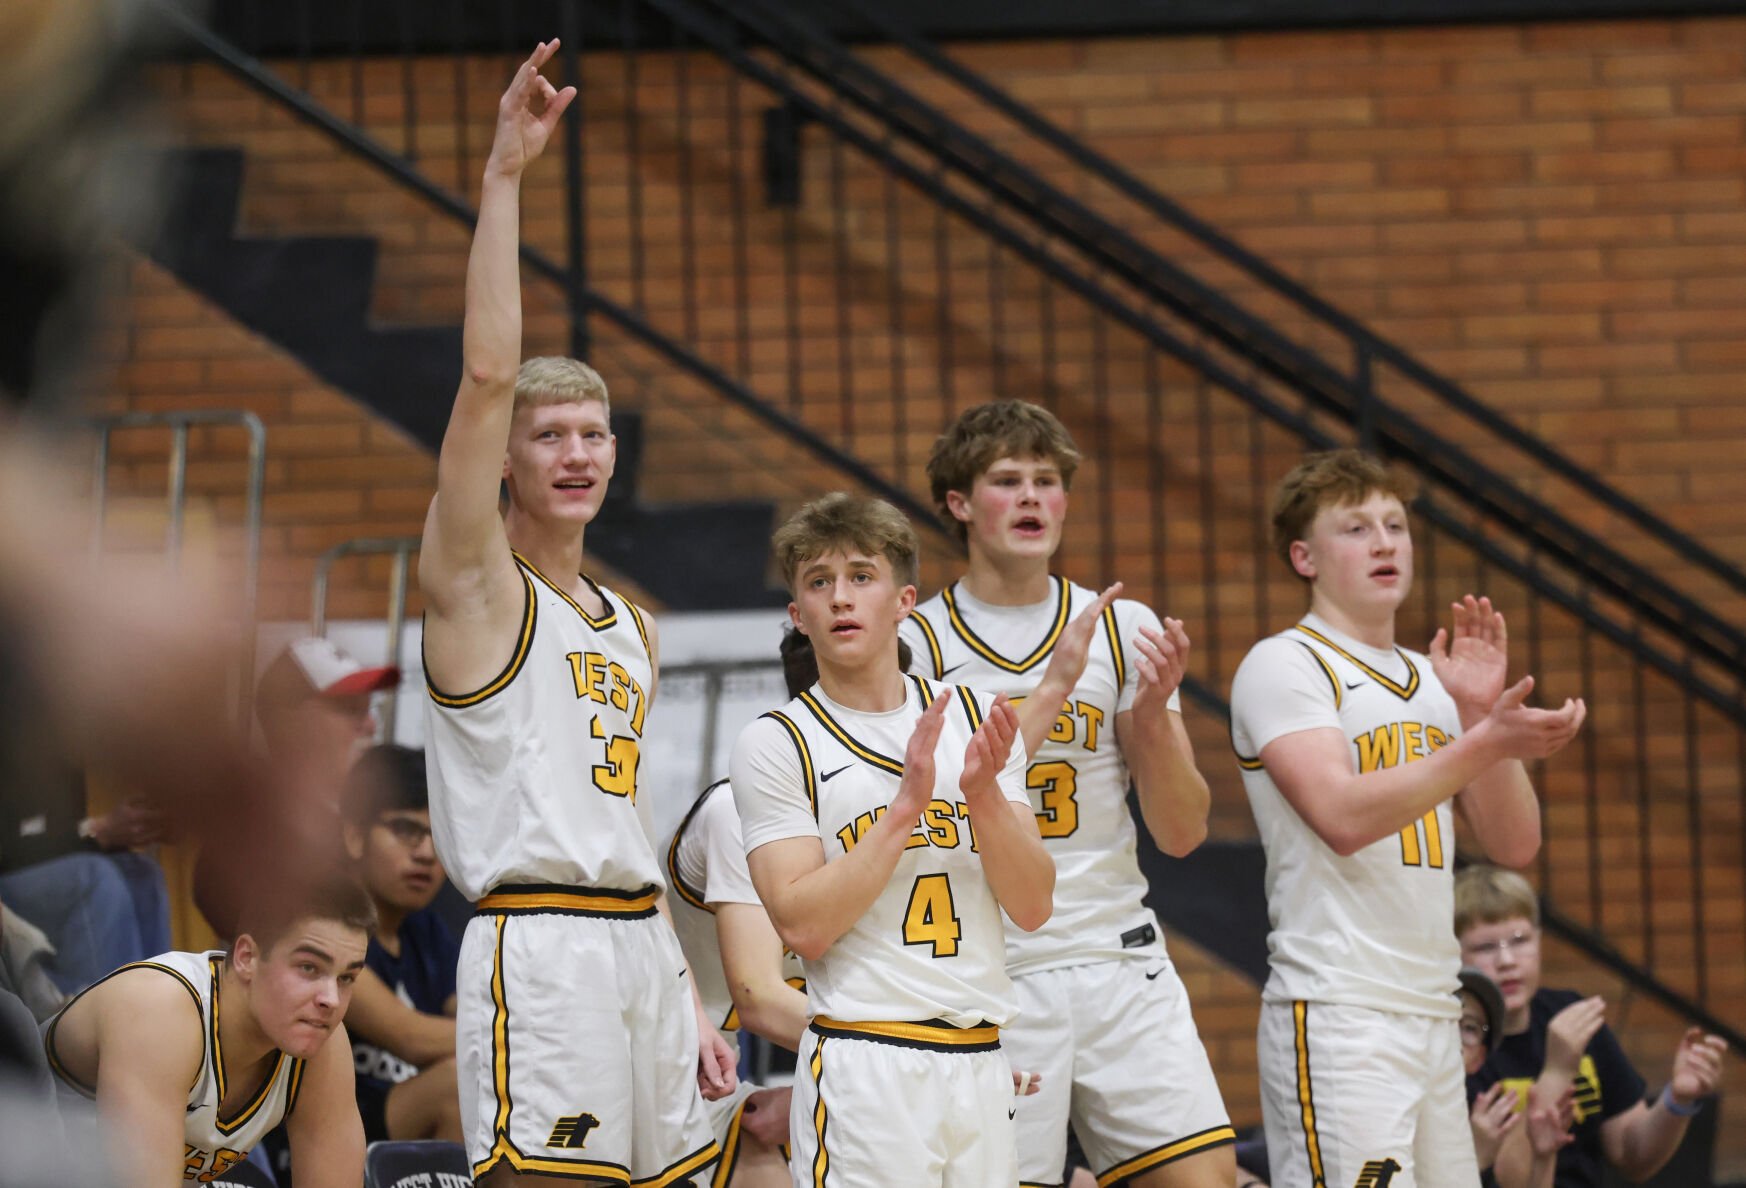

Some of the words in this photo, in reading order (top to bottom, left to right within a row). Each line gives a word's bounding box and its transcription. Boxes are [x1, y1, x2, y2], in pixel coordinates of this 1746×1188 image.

[1008, 696, 1104, 752] ST
[1353, 722, 1456, 774] WES
[1026, 760, 1079, 840] 3
[902, 873, 962, 959] 4
